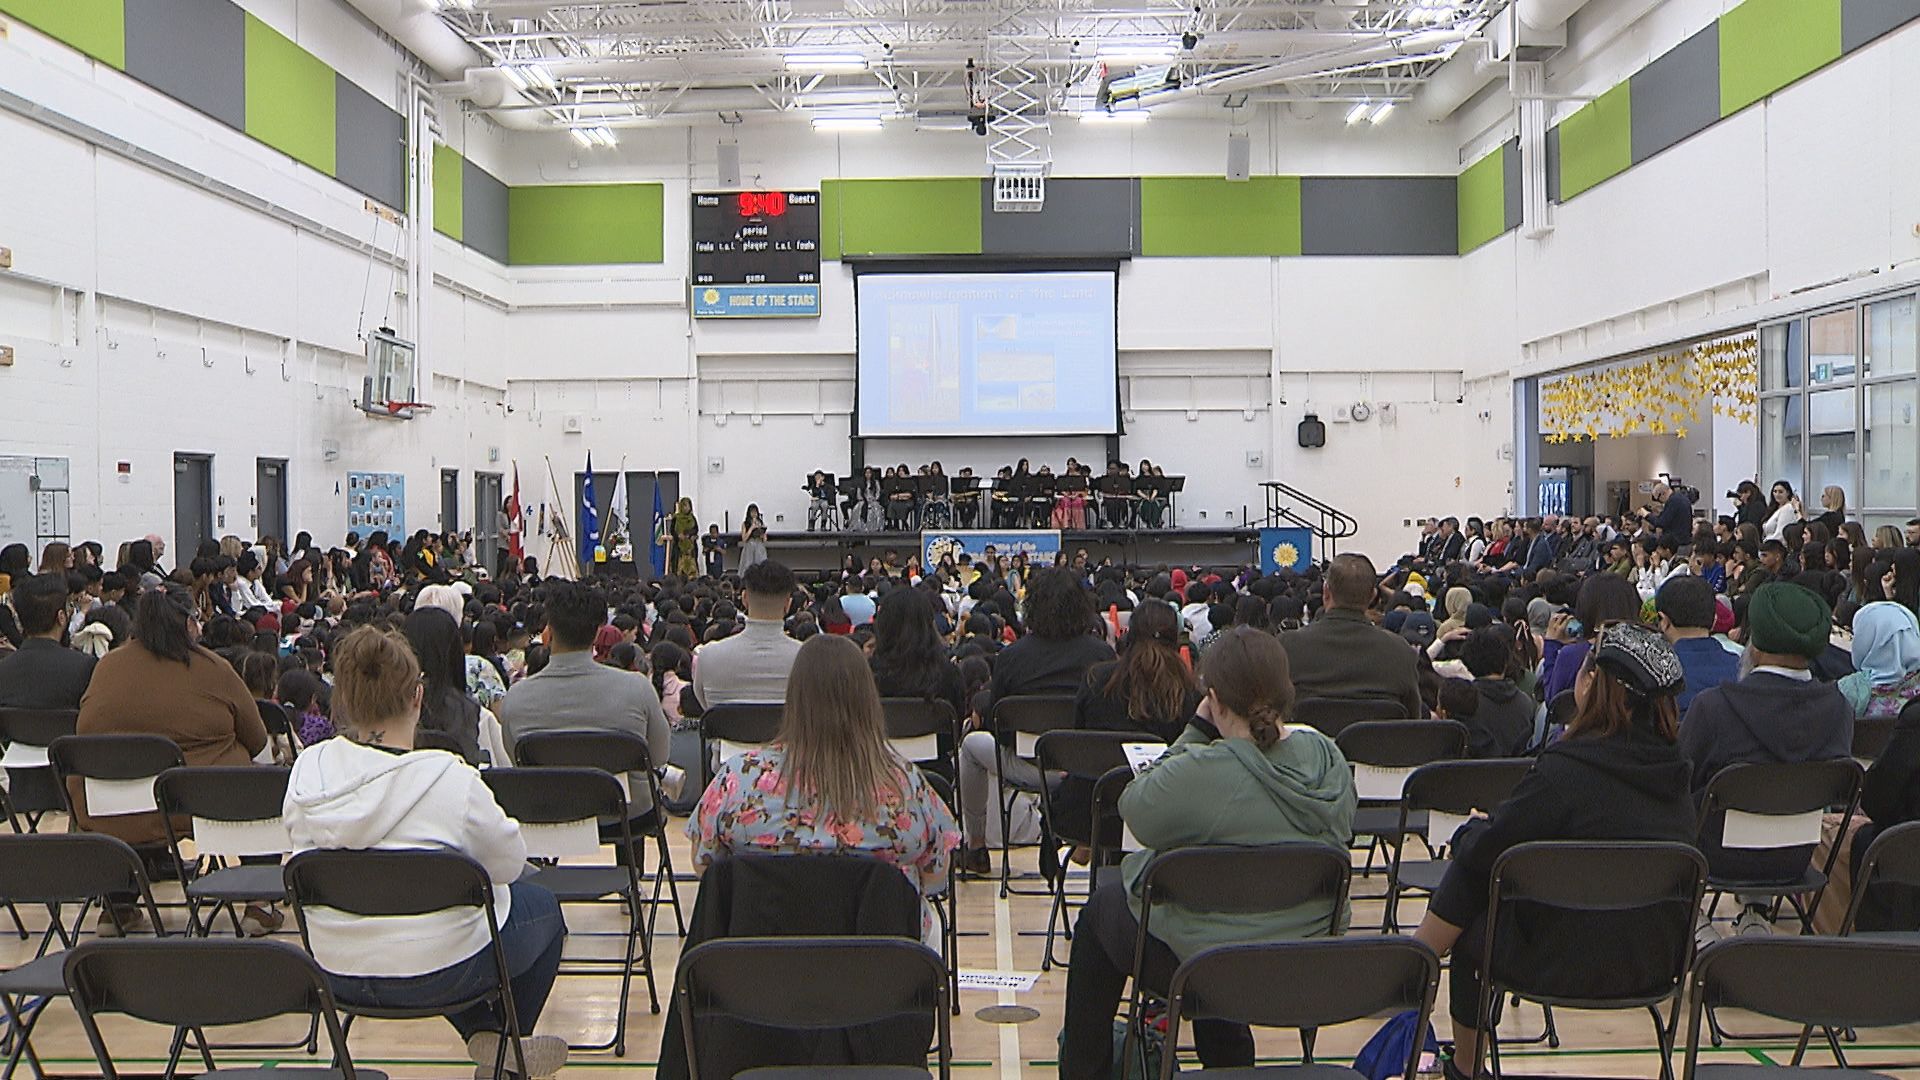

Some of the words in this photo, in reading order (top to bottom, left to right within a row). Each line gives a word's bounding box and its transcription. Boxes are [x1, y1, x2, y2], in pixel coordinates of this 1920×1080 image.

[698, 195, 719, 206] Home
[739, 192, 785, 216] 9:40
[788, 194, 816, 204] Guests
[743, 226, 768, 238] period
[696, 242, 714, 252] fouls
[743, 241, 768, 252] player
[796, 241, 815, 250] fouls
[745, 275, 766, 284] game
[729, 296, 755, 306] HOME
[756, 295, 768, 306] OF
[769, 295, 786, 306] THE
[787, 294, 815, 306] STARS
